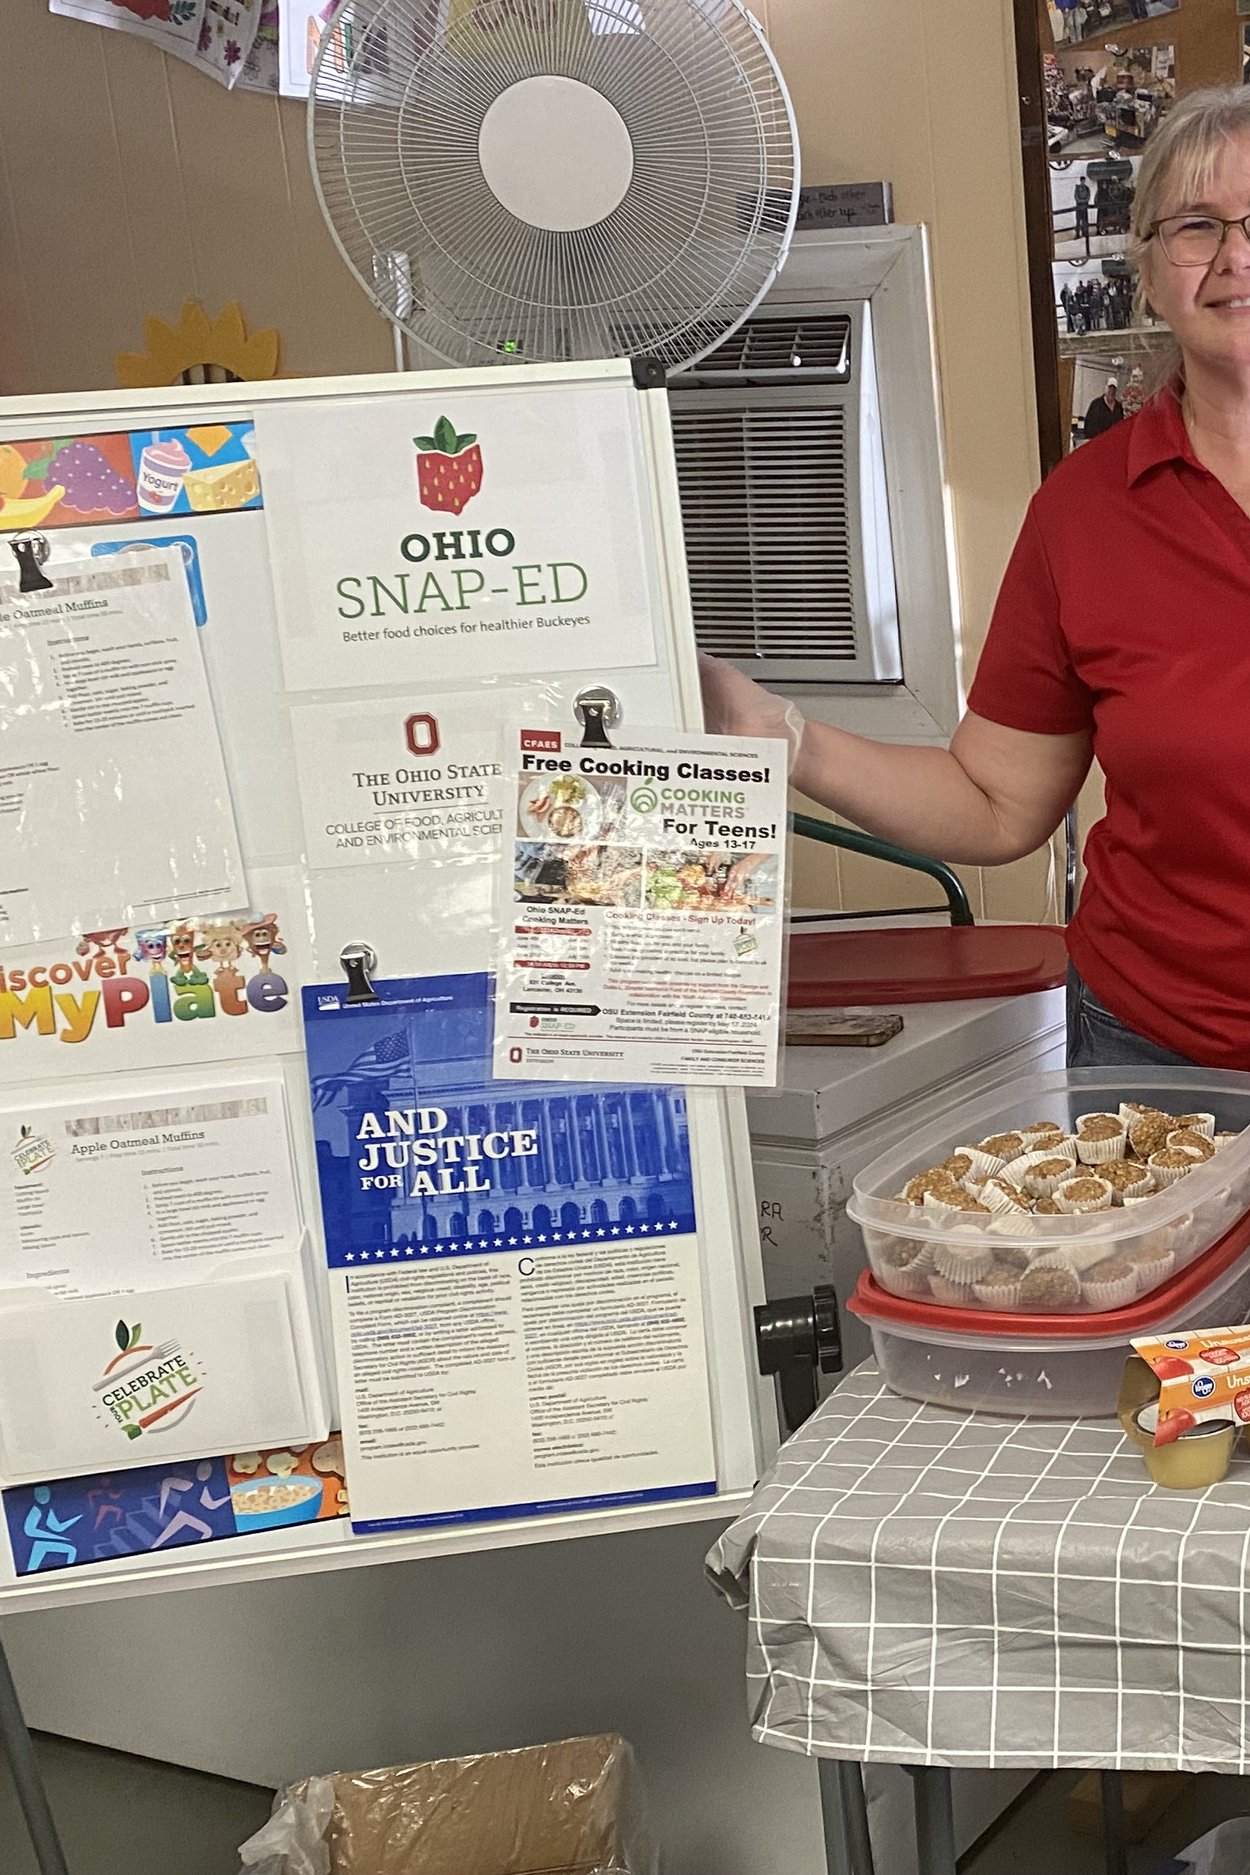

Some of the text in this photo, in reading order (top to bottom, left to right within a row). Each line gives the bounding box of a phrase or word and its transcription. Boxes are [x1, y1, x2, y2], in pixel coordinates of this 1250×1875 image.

[142, 471, 180, 493] Yogurt
[400, 528, 515, 563] OHIO
[336, 562, 588, 619] SNAP-ED
[13, 604, 64, 620] Oatmeal
[65, 598, 108, 614] Muffins
[343, 614, 590, 642] Better food choices for healthier Buckeyes
[524, 739, 558, 749] CFAES
[522, 754, 770, 783] Free Cooking Classes!
[660, 788, 745, 804] COOKING
[660, 803, 745, 818] MATTERS
[325, 820, 381, 836] COLLEGE
[384, 818, 400, 829] OF
[404, 816, 444, 828] FOOD,
[663, 819, 777, 838] For Teens!
[336, 837, 364, 848] AND
[366, 827, 471, 847] ENVIRONMENTAL
[689, 838, 756, 850] Ages 13-17
[522, 915, 556, 925] Cooking
[548, 907, 585, 915] SNAP-Ed
[606, 912, 643, 922] Cooking
[688, 915, 708, 924] Sign
[711, 916, 724, 924] Up
[726, 916, 756, 926] Today!
[621, 1009, 656, 1017] Extension
[658, 1010, 686, 1018] Fairfield
[689, 1011, 714, 1021] County
[355, 1106, 448, 1140] AND
[71, 1142, 107, 1155] Apple
[110, 1135, 160, 1150] Oatmeal
[162, 1130, 206, 1144] Muffins
[358, 1128, 539, 1171] JUSTICE
[360, 1165, 491, 1198] FOR ALL
[760, 1200, 784, 1221] RA
[102, 1355, 186, 1407] CELEBRATE
[115, 1366, 198, 1420] PLATE
